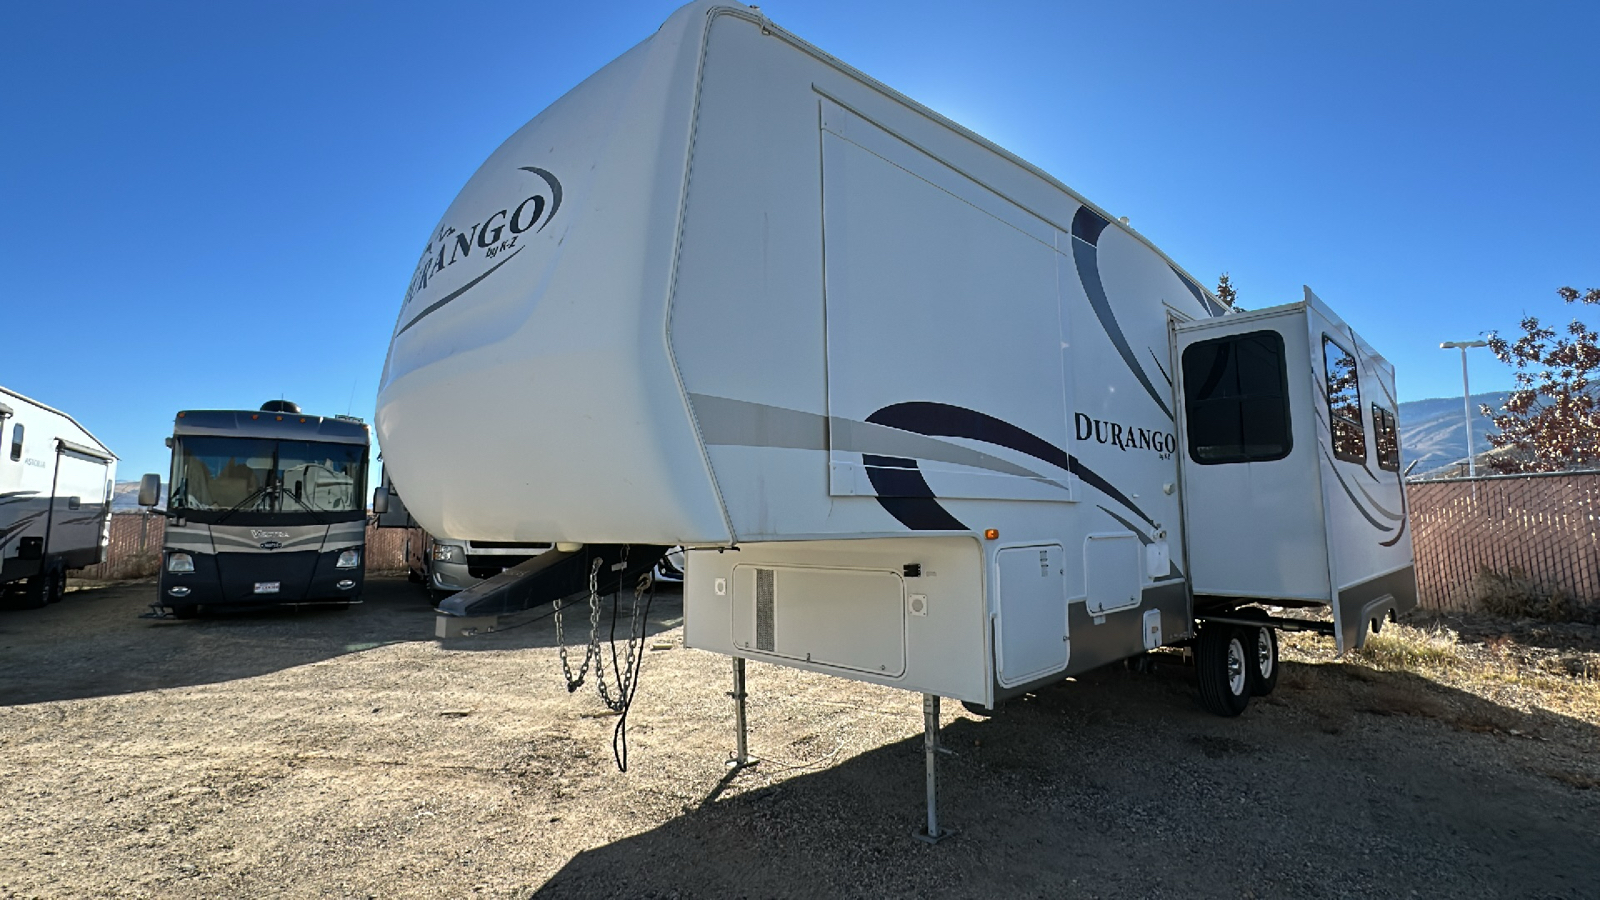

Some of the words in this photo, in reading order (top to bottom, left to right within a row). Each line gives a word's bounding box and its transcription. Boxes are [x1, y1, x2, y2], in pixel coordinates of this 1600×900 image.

[404, 195, 545, 304] URANGO
[486, 246, 499, 258] by
[1074, 412, 1176, 453] DURANGO
